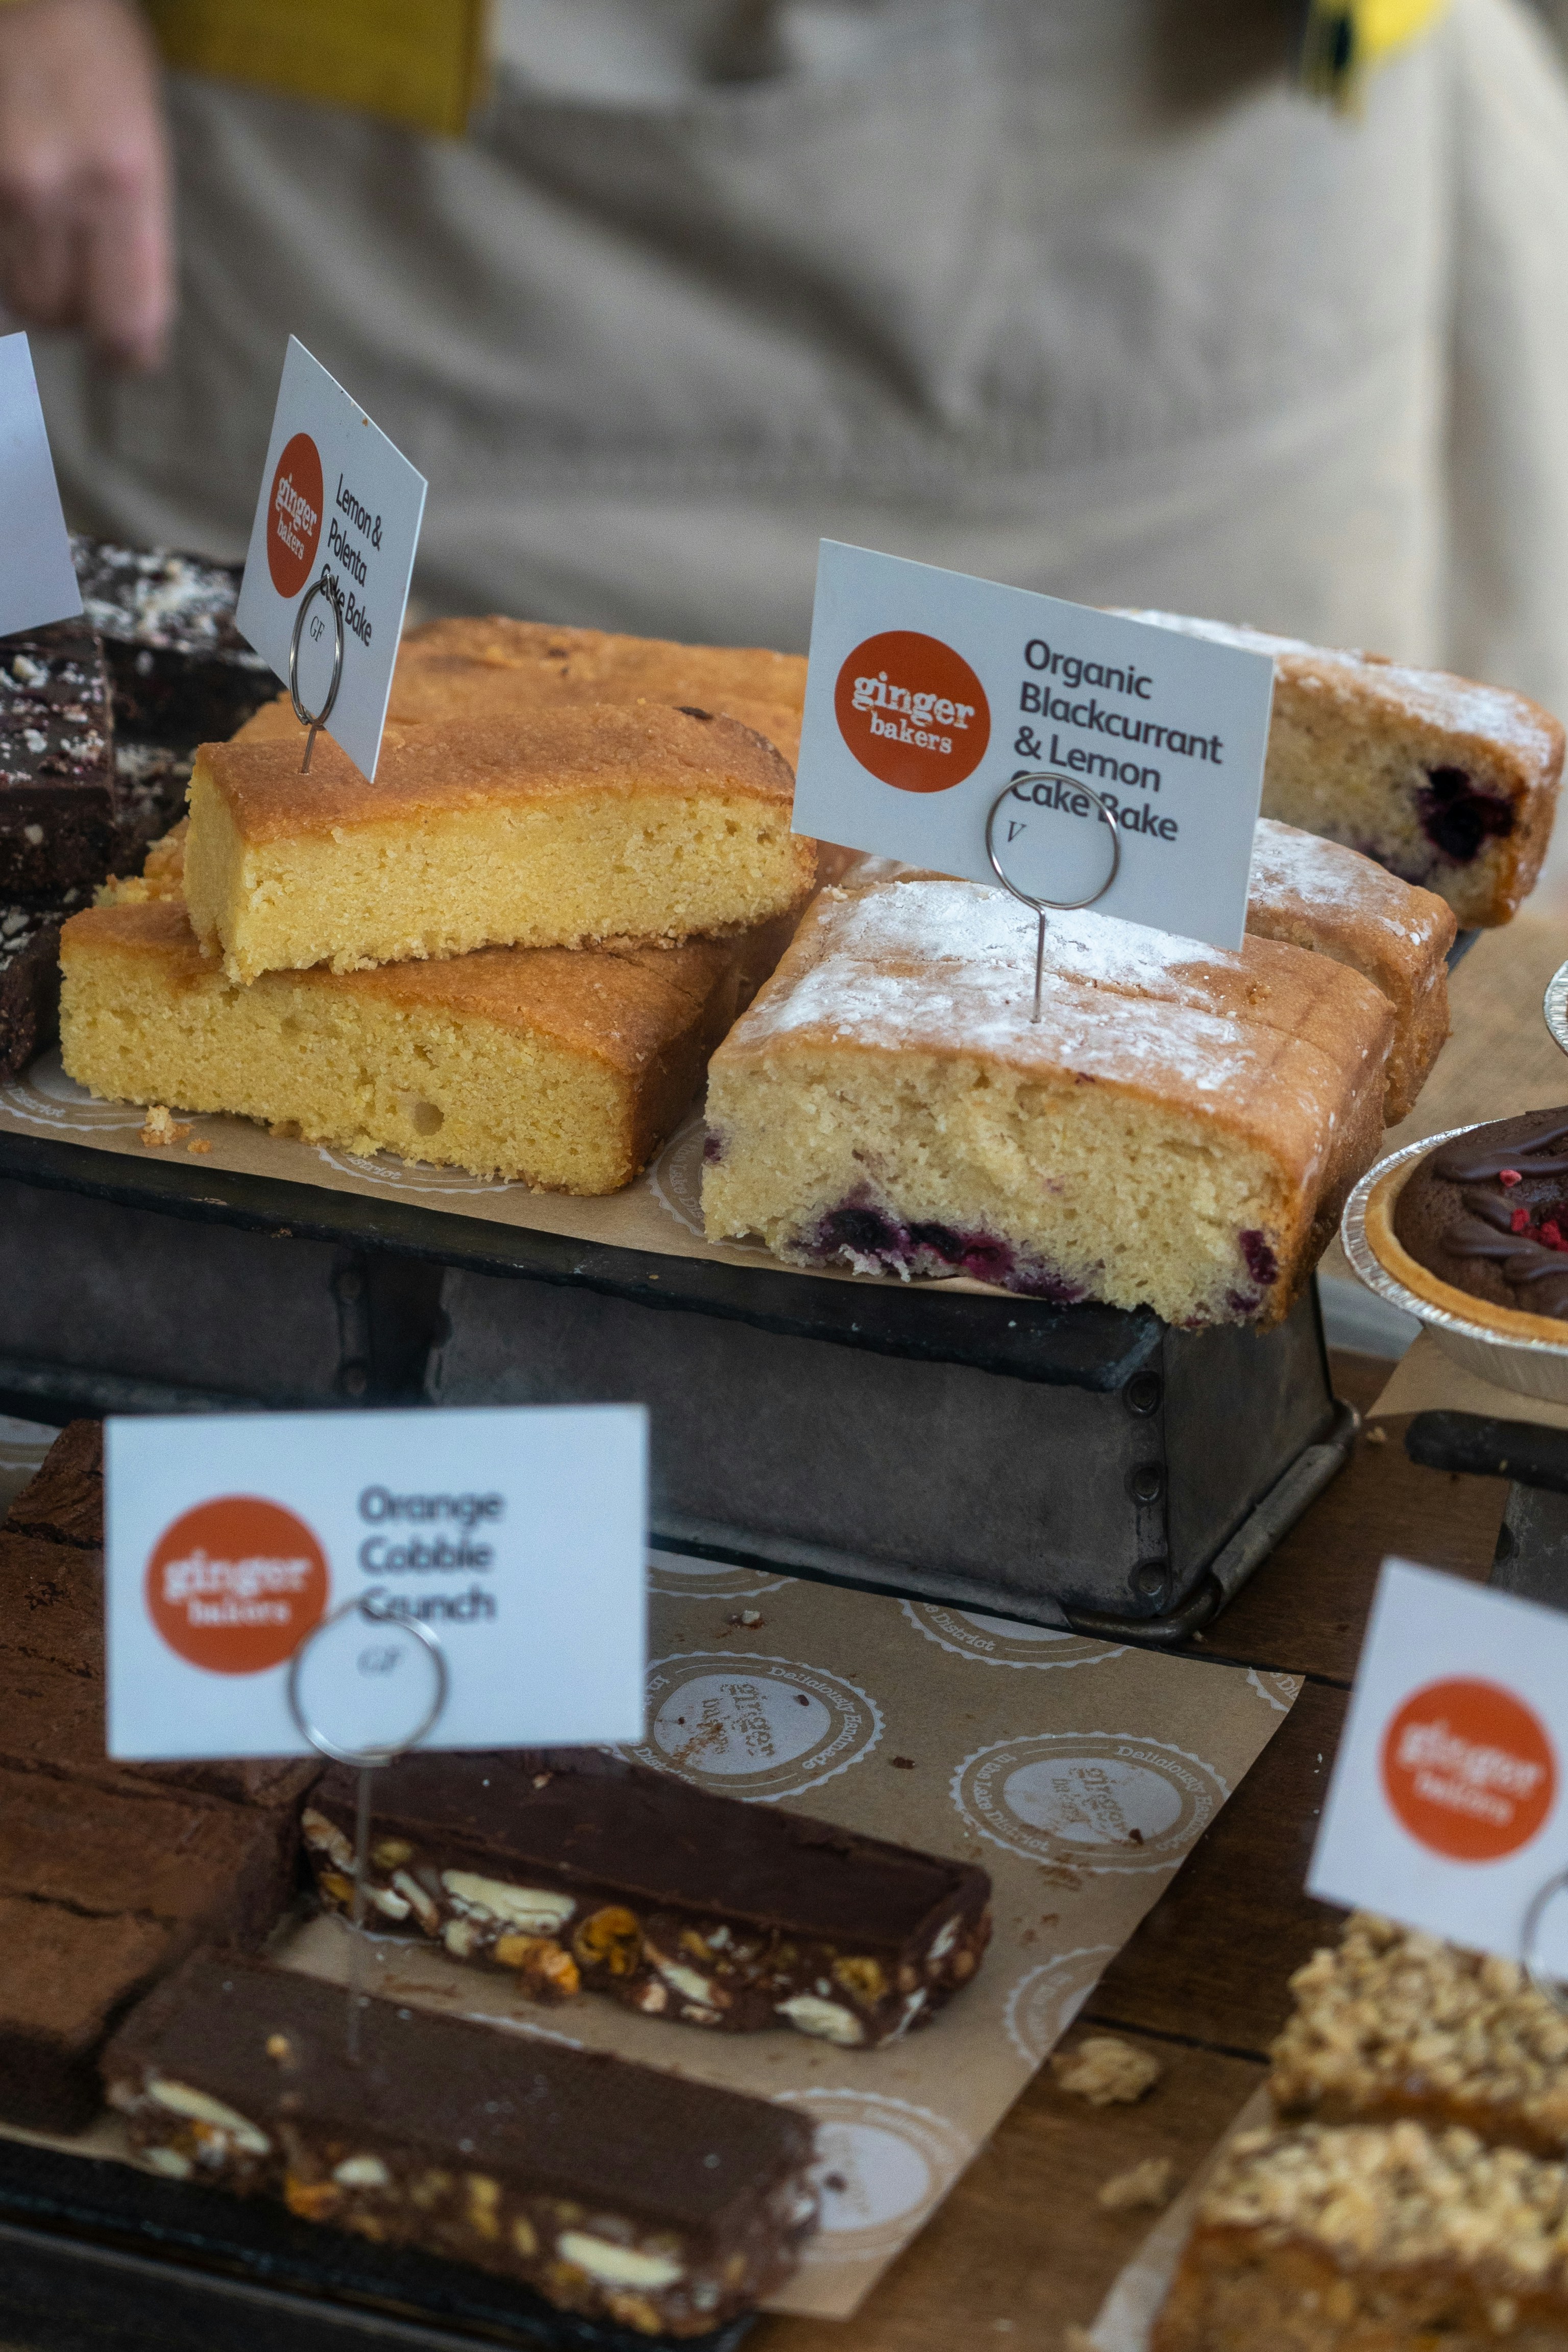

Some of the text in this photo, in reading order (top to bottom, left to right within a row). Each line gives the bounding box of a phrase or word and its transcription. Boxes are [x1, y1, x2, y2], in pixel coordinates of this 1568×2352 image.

[276, 473, 317, 537] ginger
[335, 473, 383, 552] Lemon &
[277, 510, 305, 560] bakers
[328, 517, 368, 587] Polenta
[310, 616, 325, 642] GF
[345, 591, 372, 647] Bake
[1024, 639, 1153, 700] Organic
[851, 671, 975, 730] ginger
[1020, 681, 1224, 765] Blackcurrant
[870, 709, 952, 754] bakers
[1014, 725, 1161, 793] & Lemon
[1007, 820, 1027, 843] V
[1010, 769, 1179, 842] Cake Bake
[358, 1484, 505, 1532] Orange
[358, 1533, 494, 1576] Cobble
[358, 1585, 497, 1626] Crunch
[930, 1613, 995, 1651] District
